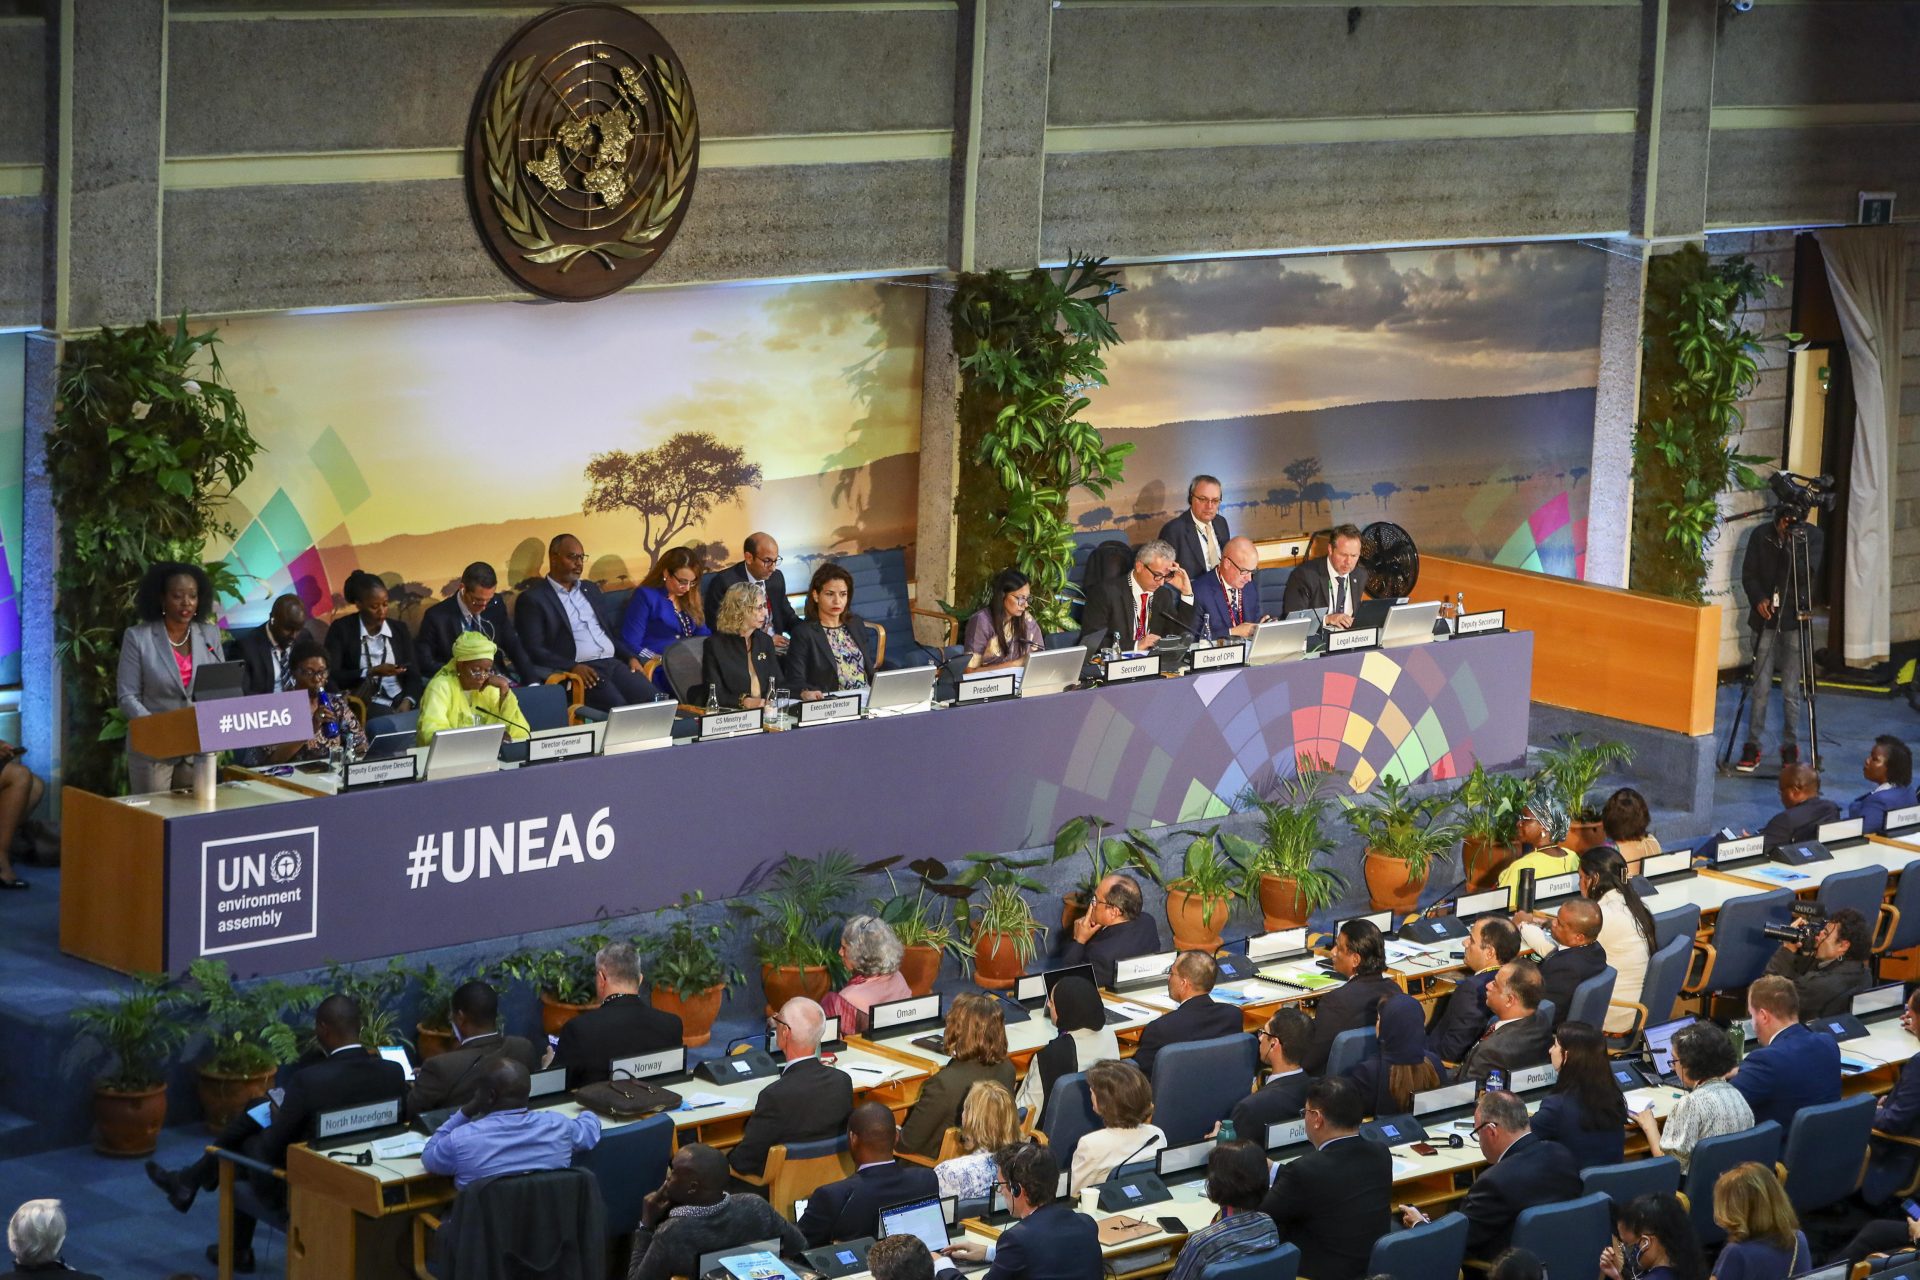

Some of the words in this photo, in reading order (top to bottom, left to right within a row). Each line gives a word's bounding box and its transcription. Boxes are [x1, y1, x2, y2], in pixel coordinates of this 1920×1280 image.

[1461, 620, 1477, 629] Deputy
[1479, 617, 1500, 627] Secretary
[1337, 636, 1351, 646] Legal
[1217, 653, 1223, 661] of
[1223, 652, 1235, 660] CPR
[1121, 664, 1146, 674] Secretary
[973, 684, 999, 694] President
[810, 703, 832, 711] Executive
[832, 701, 850, 709] Director
[219, 708, 292, 733] #UNEA6
[541, 741, 560, 749] Director
[561, 737, 581, 746] General
[349, 767, 367, 776] Deputy
[367, 764, 392, 773] Executive
[393, 761, 414, 769] Director
[406, 806, 615, 889] #UNEA6
[218, 853, 266, 892] UN
[1549, 882, 1571, 892] Panama
[218, 887, 302, 913] environment
[218, 909, 283, 933] assembly
[896, 1008, 917, 1018] Oman
[634, 1060, 663, 1073] Norway
[1527, 1068, 1554, 1084] Portugal
[325, 1116, 348, 1130] North
[350, 1109, 393, 1124] Macedonia
